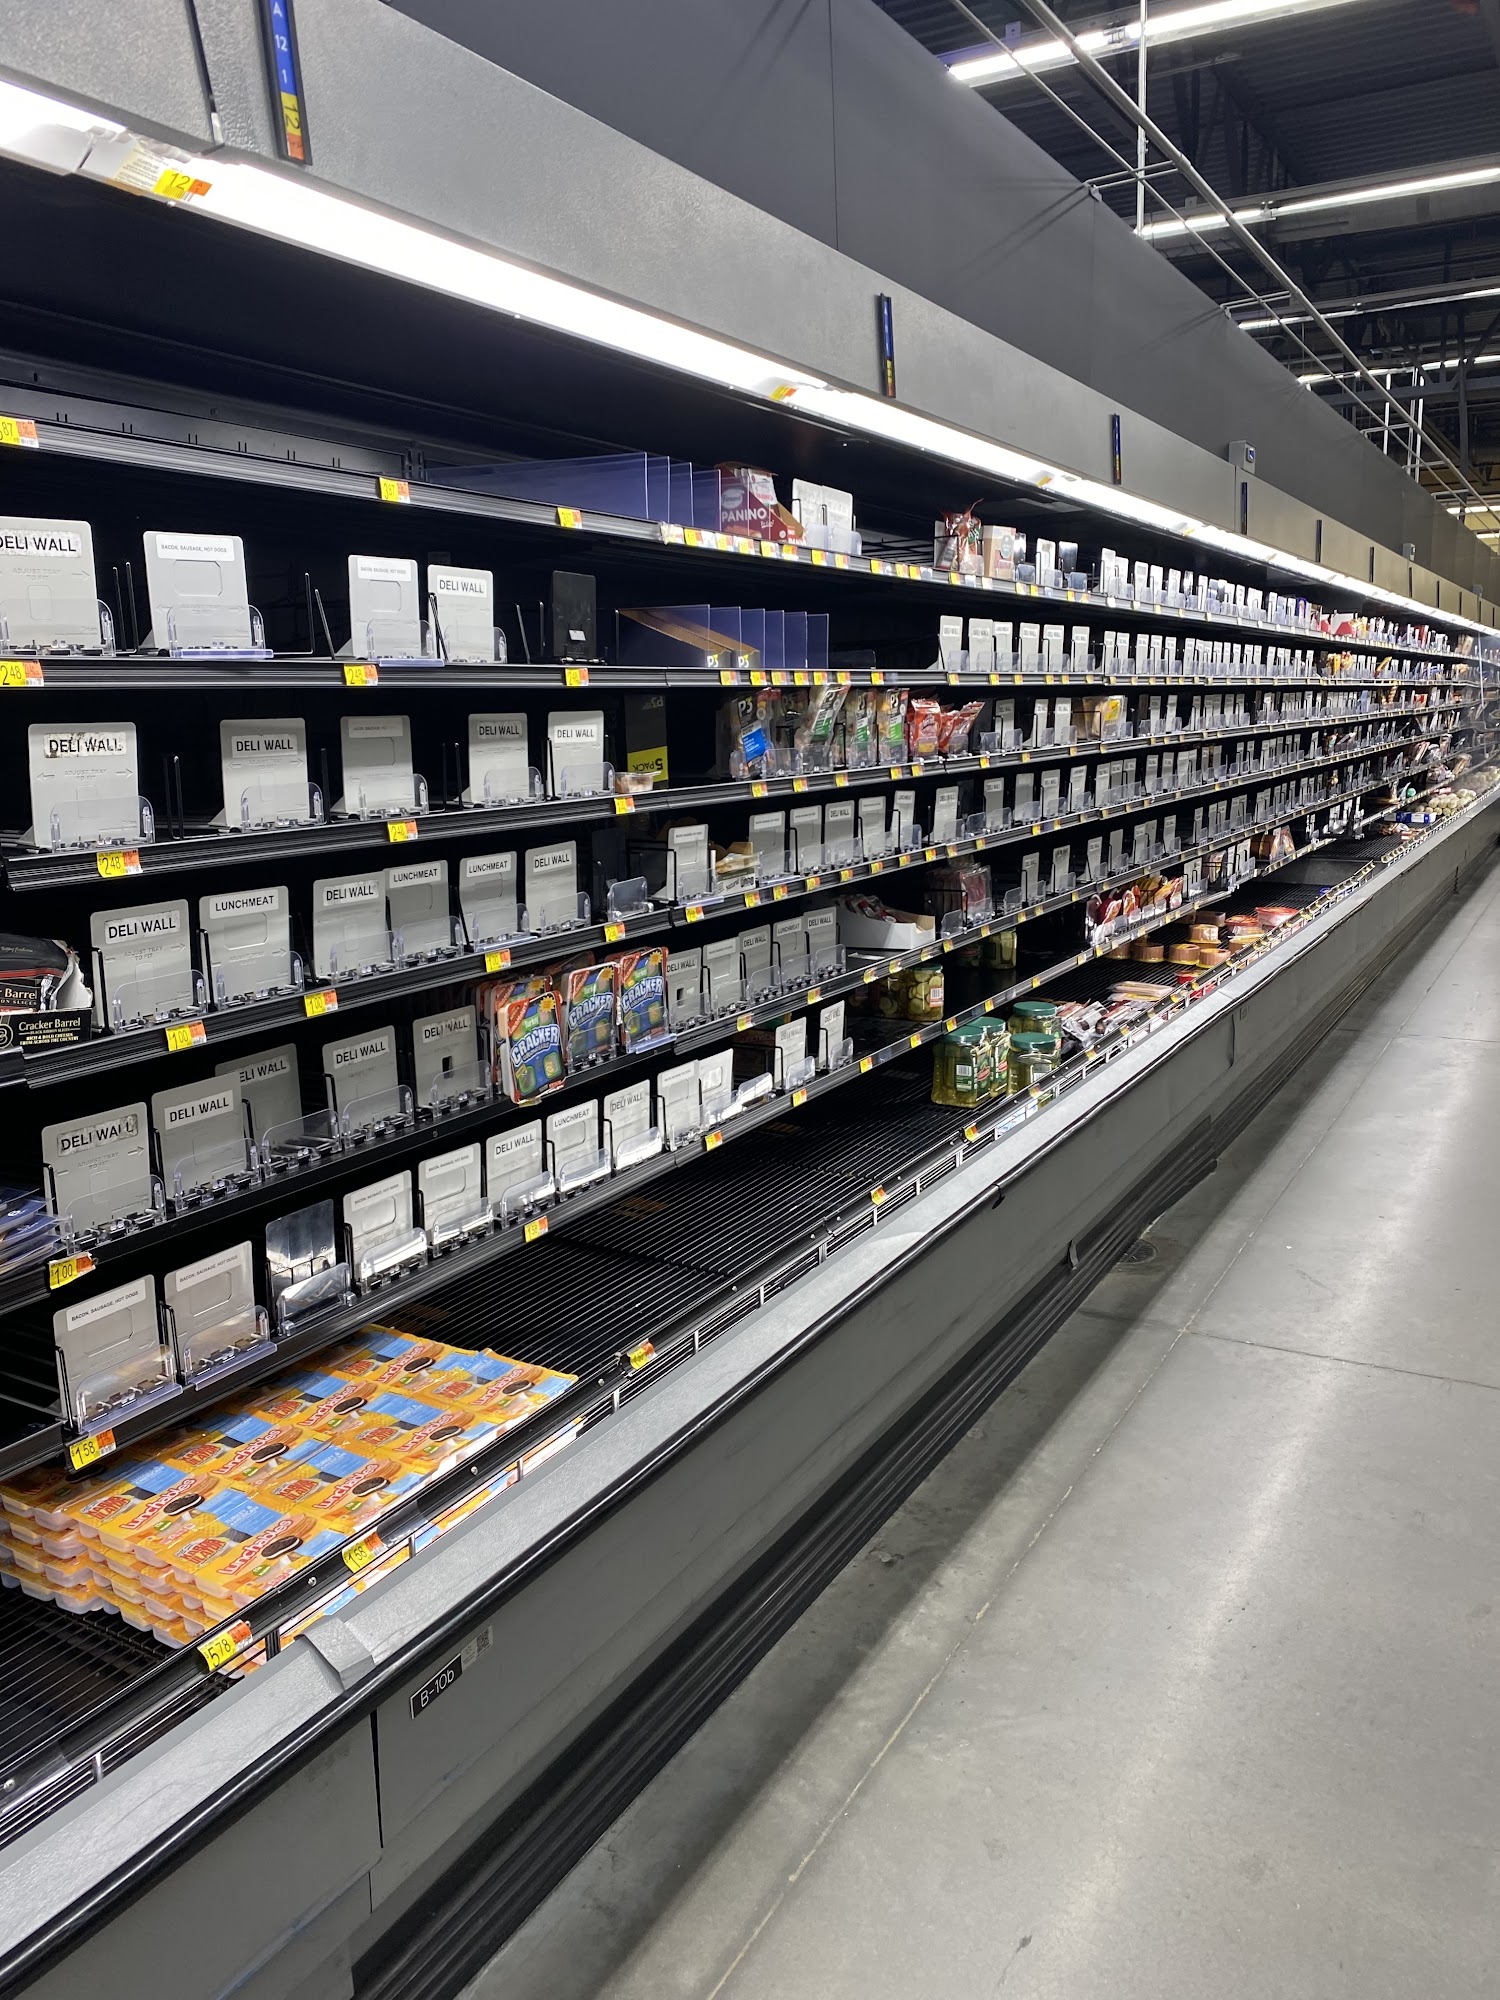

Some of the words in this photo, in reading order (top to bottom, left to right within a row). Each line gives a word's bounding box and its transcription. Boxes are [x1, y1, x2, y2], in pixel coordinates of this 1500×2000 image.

[273, 1, 283, 17] A
[275, 34, 288, 51] 12
[281, 69, 288, 84] 1
[284, 103, 300, 130] 12
[169, 173, 191, 193] 12
[721, 507, 767, 522] PANINO
[33, 537, 76, 552] WALL
[439, 579, 459, 591] DELI
[461, 581, 484, 593] WALL
[706, 654, 719, 668] P3
[738, 654, 749, 668] P3
[0, 664, 22, 685] 248
[738, 697, 753, 714] P3
[478, 725, 497, 736] DELI
[498, 724, 520, 735] WALL
[557, 729, 573, 739] DELI
[575, 728, 595, 737] WALL
[49, 739, 80, 753] DELI
[85, 737, 122, 752] WALL
[236, 740, 260, 752] DELI
[264, 739, 294, 750] WALL
[632, 761, 655, 772] PACK
[655, 758, 664, 770] 5
[468, 861, 508, 874] LUNCHMEAT
[534, 858, 550, 869] DELI
[551, 853, 570, 865] WALL
[393, 868, 438, 883] LUNCHMEAT
[326, 888, 347, 901] DELI
[348, 885, 374, 899] WALL
[215, 895, 275, 912] LUNCHMEAT
[108, 922, 138, 939] DELI
[141, 917, 176, 934] WALL
[808, 917, 819, 927] DELI
[820, 915, 832, 925] WALL
[743, 938, 754, 948] DELI
[667, 961, 680, 973] DELI
[680, 958, 696, 970] WALL
[4, 988, 38, 999] Barrel
[622, 978, 663, 1011] CRACKER
[569, 994, 614, 1027] CRACKER
[19, 1020, 54, 1031] Cracker
[54, 1017, 81, 1028] Barrel
[424, 1025, 444, 1039] DELI
[336, 1053, 358, 1065] DELI
[359, 1041, 386, 1057] WALL
[511, 1027, 559, 1066] CRACKER
[239, 1068, 255, 1083] ELI
[257, 1060, 287, 1077] WALL
[626, 1093, 643, 1106] WALL
[169, 1106, 195, 1123] DELI
[199, 1097, 229, 1114] WALL
[554, 1108, 590, 1128] LUNCHMEAT
[61, 1132, 92, 1151] DELI
[495, 1141, 513, 1155] DELI
[513, 1133, 535, 1148] WALL
[179, 1273, 195, 1283] BACON,
[196, 1264, 216, 1276] SAUSAGE,
[217, 1260, 226, 1268] HOT
[226, 1255, 238, 1264] DOGS
[71, 1310, 90, 1322] BACON,
[90, 1300, 114, 1314] SAUSAGE,
[114, 1295, 125, 1304] HOT
[125, 1290, 139, 1301] DOGS
[297, 1385, 358, 1426] Lunchables
[392, 1413, 454, 1453] Lunchables
[210, 1429, 282, 1475] Lunchables
[312, 1463, 380, 1510] Lunchables
[119, 1478, 197, 1529] Lunchables
[216, 1519, 295, 1576] Lunchables
[420, 1668, 456, 1709] B-10b
